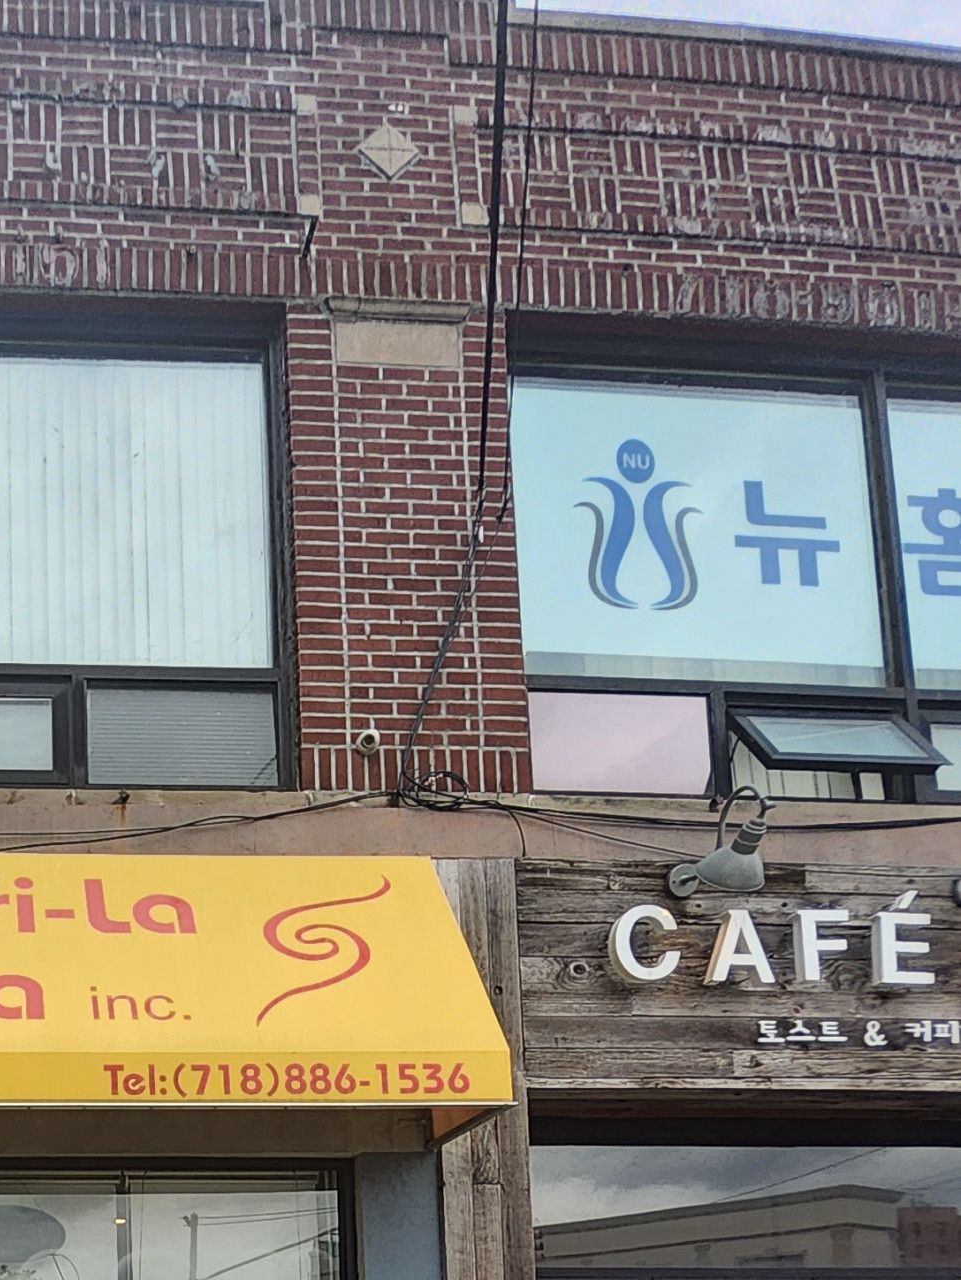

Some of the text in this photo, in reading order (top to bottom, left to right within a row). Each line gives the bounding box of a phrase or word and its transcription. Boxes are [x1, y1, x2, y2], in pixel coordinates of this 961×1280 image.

[622, 453, 650, 470] NU
[608, 890, 936, 986] CAFÉ
[90, 986, 192, 1020] inc.
[757, 1020, 960, 1046] 토스트 & 커피
[103, 1062, 470, 1098] Tel:(718)886-1536
